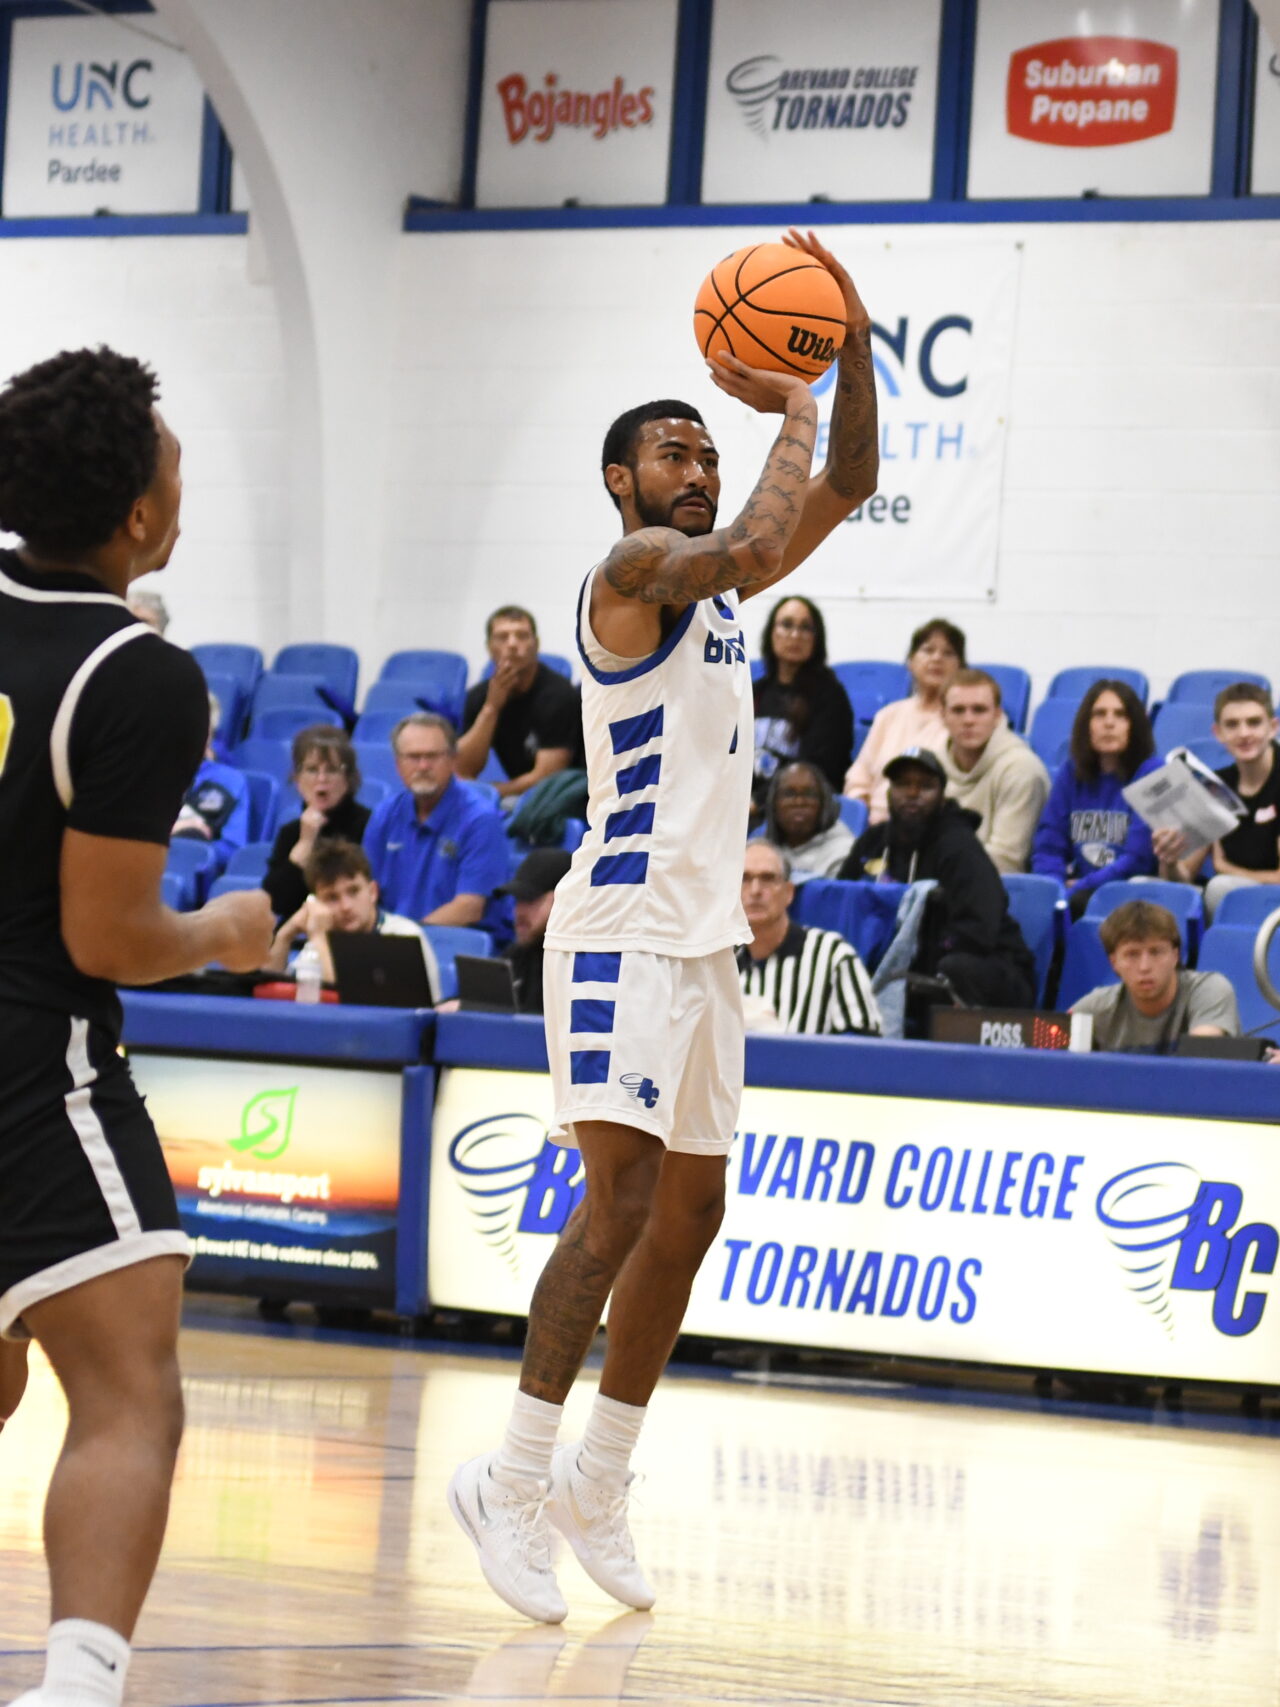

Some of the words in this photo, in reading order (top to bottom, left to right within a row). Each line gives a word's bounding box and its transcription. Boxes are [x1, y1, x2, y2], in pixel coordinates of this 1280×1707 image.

[52, 59, 153, 112] UNC
[779, 69, 851, 91] BREVARD
[853, 66, 918, 89] COLLEGE
[1025, 57, 1161, 89] Suburban
[497, 72, 656, 145] Bojangles
[772, 92, 912, 131] TORNADOS
[1030, 94, 1149, 129] Propane
[48, 121, 151, 147] HEALTH
[47, 157, 122, 183] Pardee
[815, 420, 964, 460] ELTH
[980, 1021, 1026, 1049] POSS.
[884, 1143, 1085, 1221] COLLEGE
[1169, 1180, 1280, 1338] BC
[719, 1238, 983, 1325] TORNADOS
